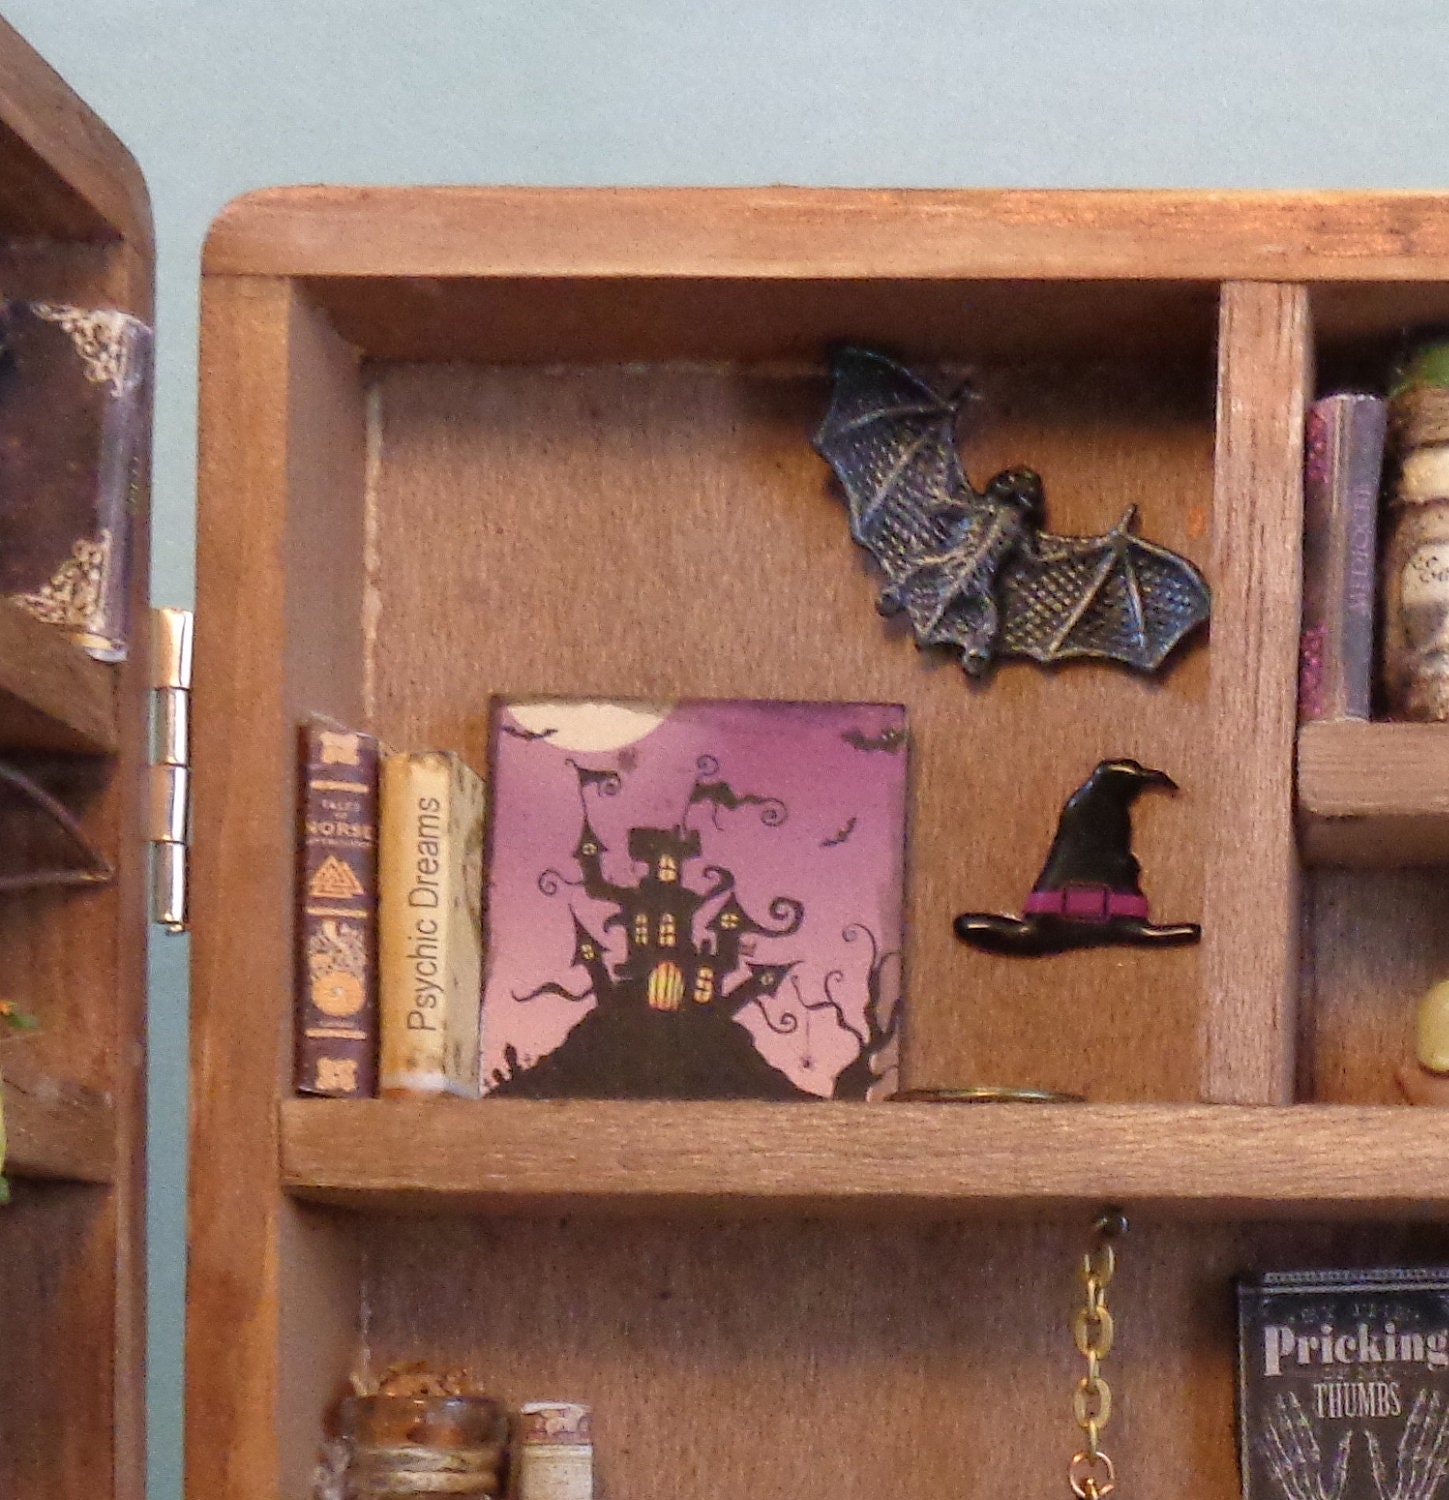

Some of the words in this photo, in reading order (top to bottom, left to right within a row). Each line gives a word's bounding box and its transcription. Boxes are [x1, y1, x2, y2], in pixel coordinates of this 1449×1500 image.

[408, 795, 441, 907] Dreams
[406, 917, 444, 1032] Psychic
[1313, 1381, 1401, 1419] THUMBS
